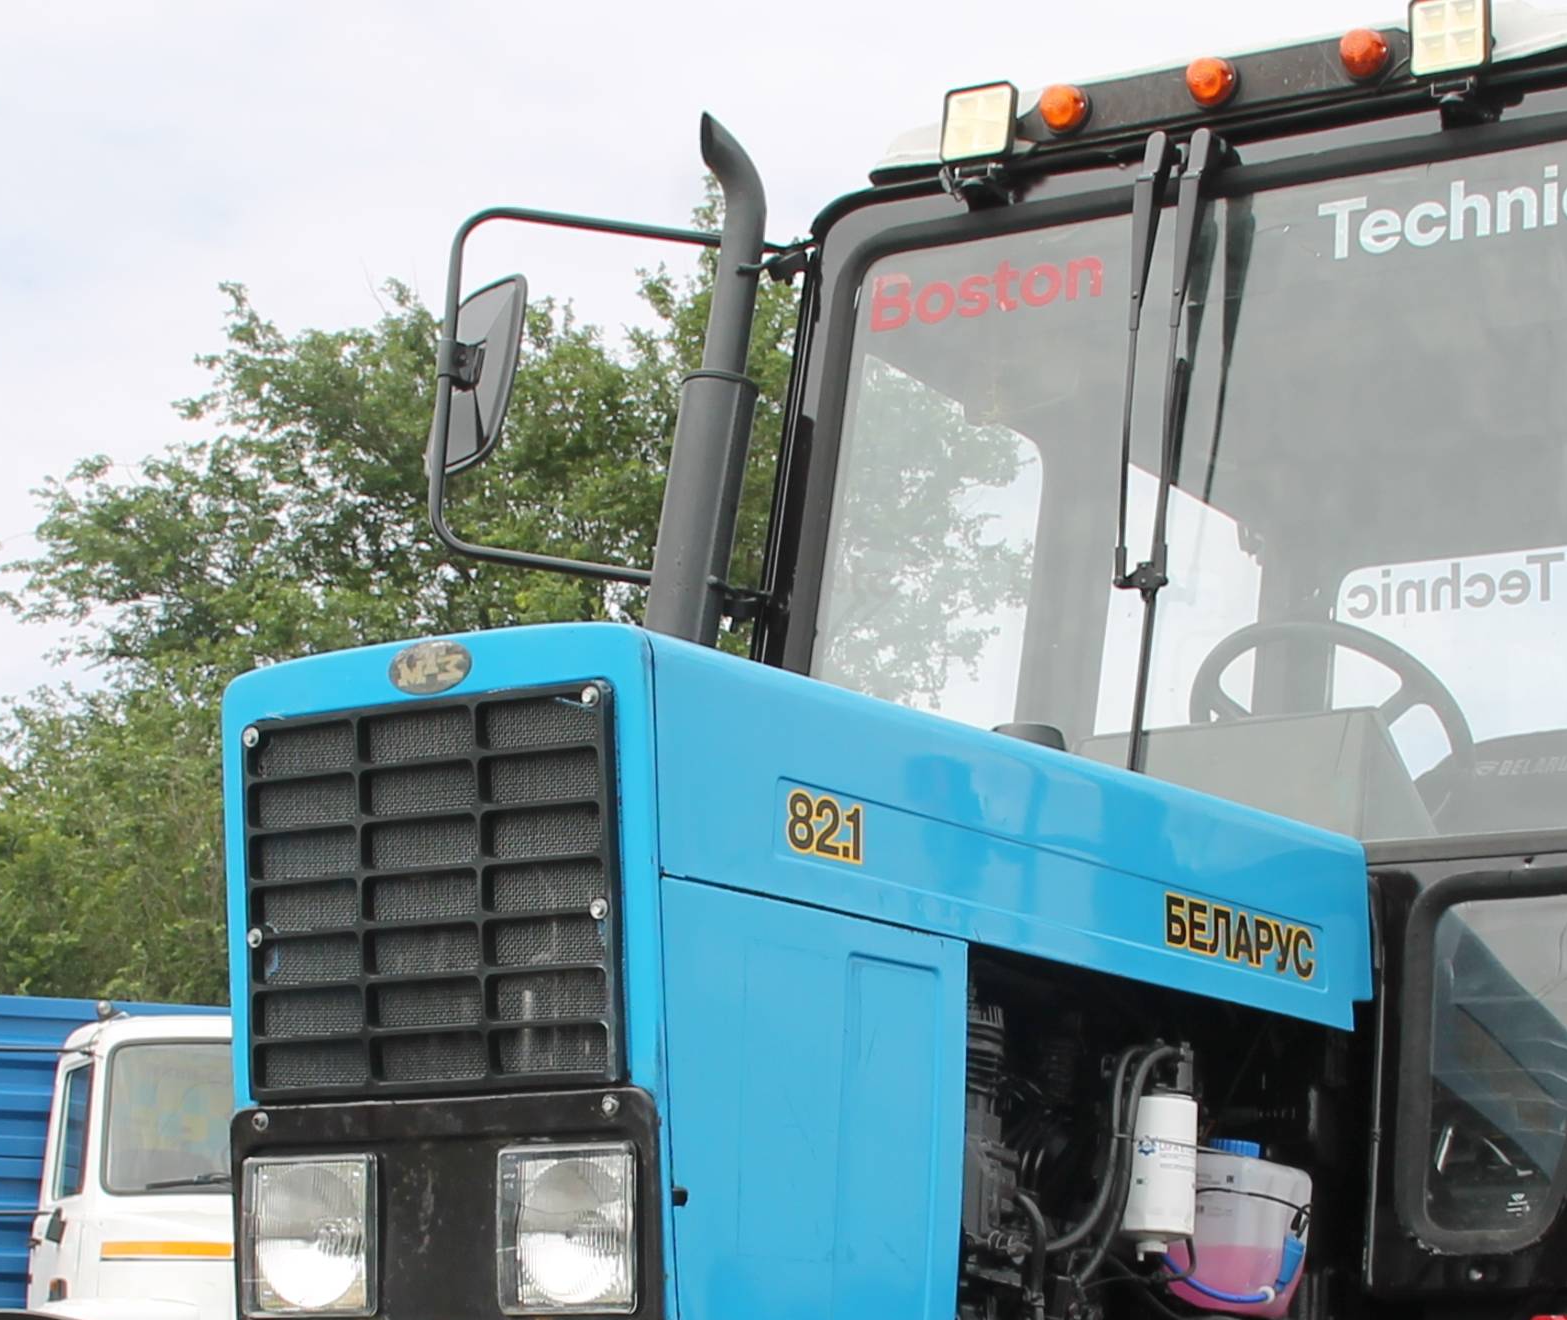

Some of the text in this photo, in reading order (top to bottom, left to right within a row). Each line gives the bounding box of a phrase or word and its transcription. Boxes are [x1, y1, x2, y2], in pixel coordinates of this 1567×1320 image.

[870, 256, 1104, 333] Boston
[786, 788, 863, 865] 82.1
[1165, 891, 1316, 980] БЕЛАРУС
